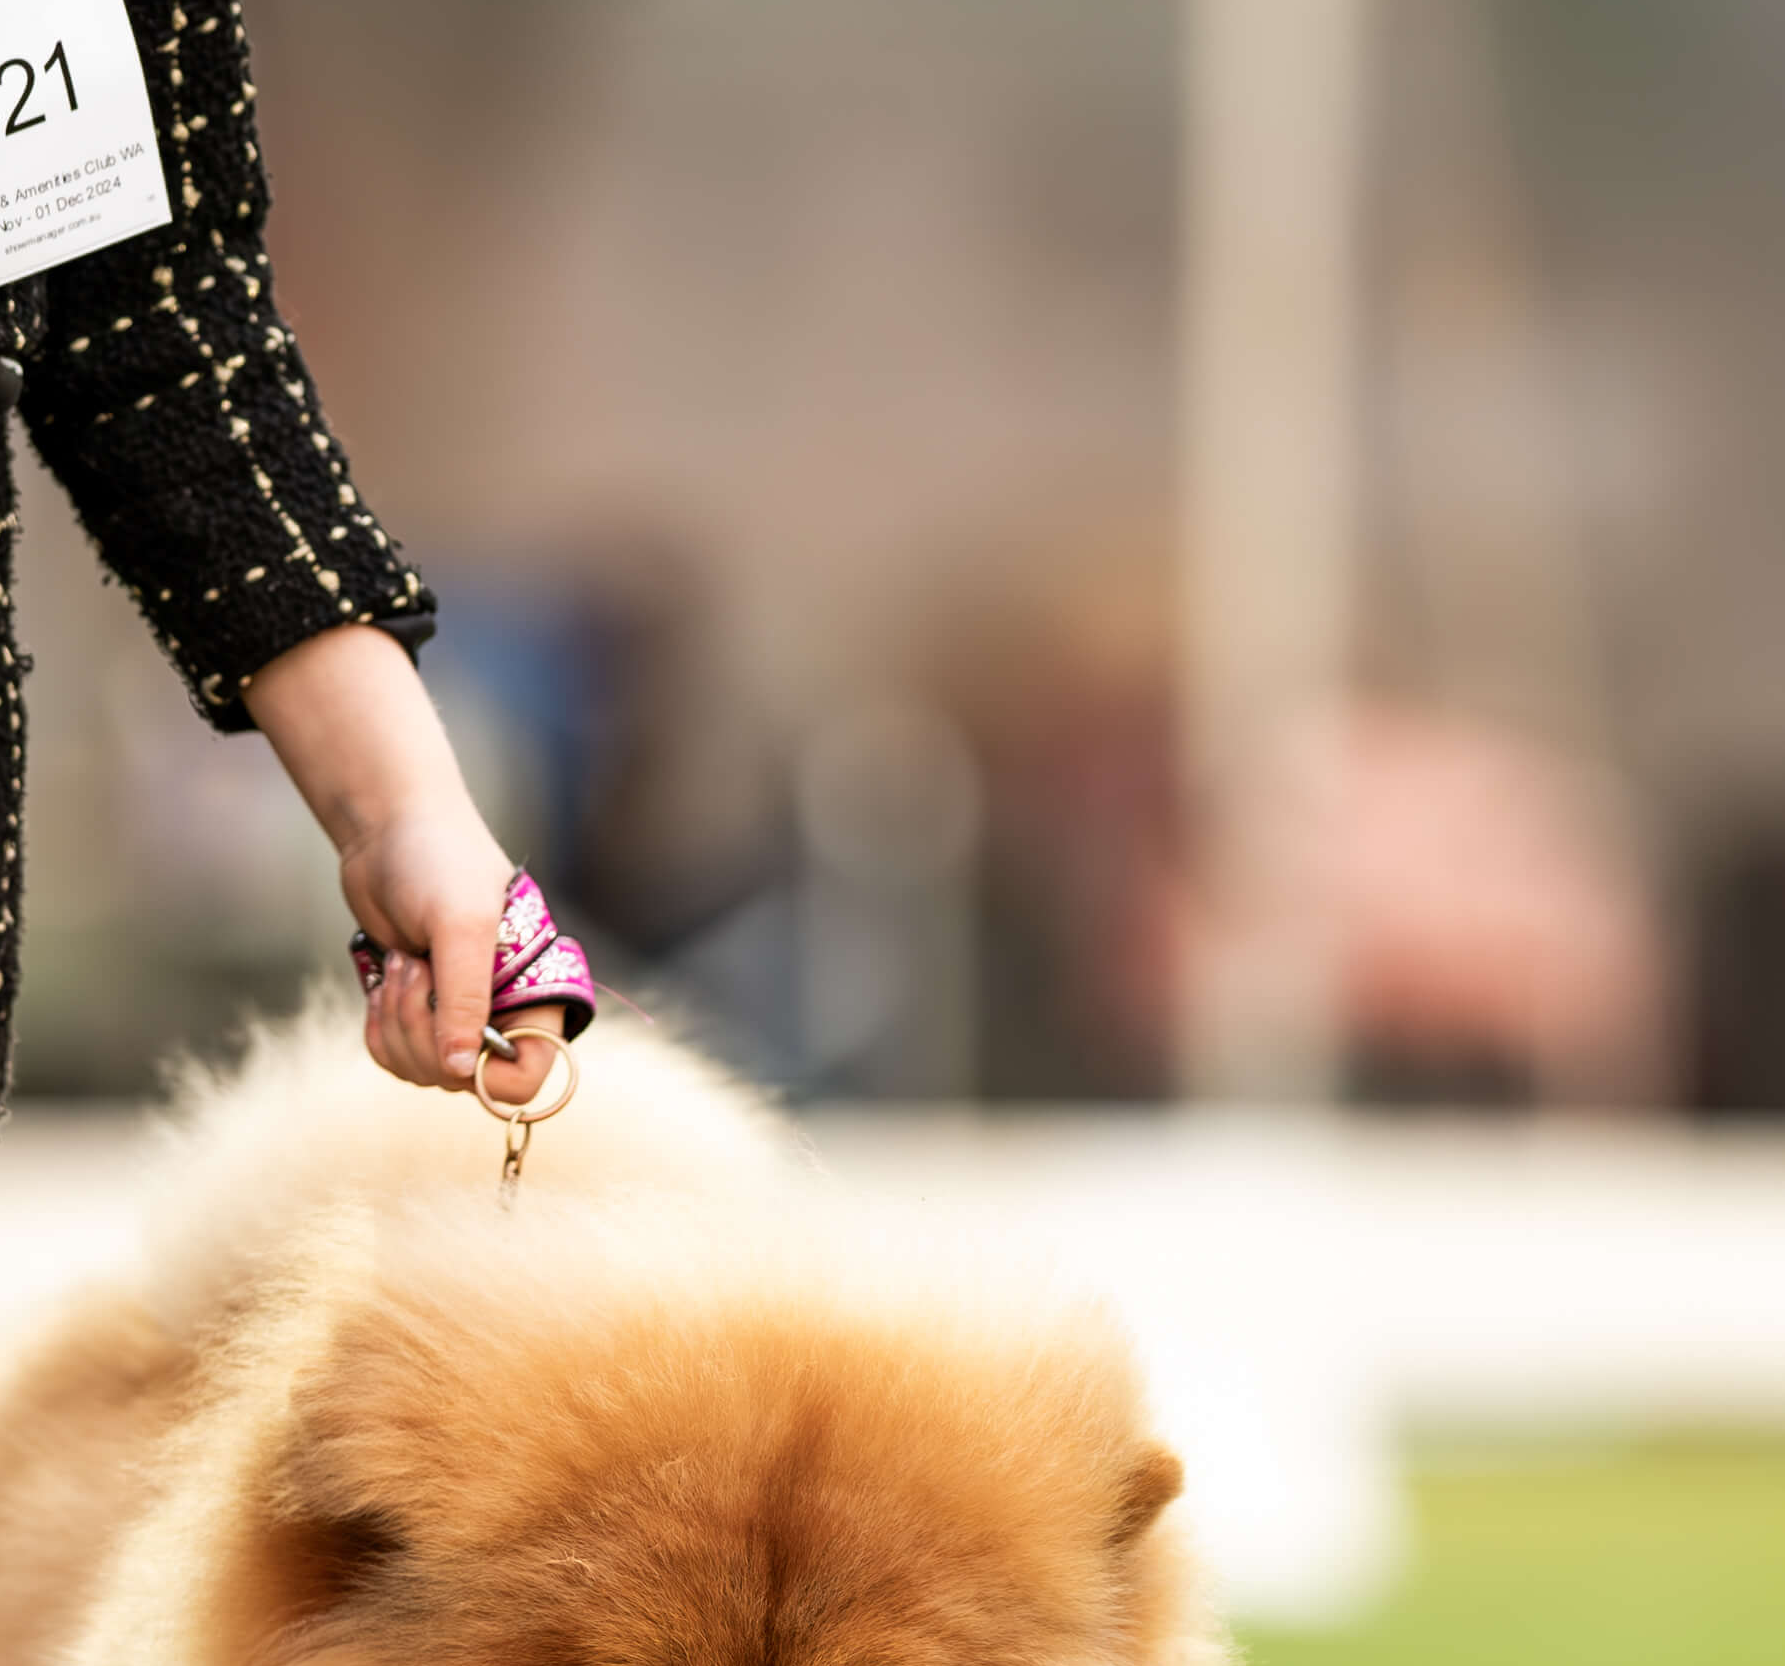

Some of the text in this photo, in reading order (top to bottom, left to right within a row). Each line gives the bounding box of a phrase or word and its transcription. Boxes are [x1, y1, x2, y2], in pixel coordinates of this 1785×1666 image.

[0, 194, 10, 208] &
[14, 169, 82, 203] Amenities
[84, 155, 116, 175] Club
[119, 142, 145, 161] WA
[35, 203, 51, 220] 01
[55, 193, 84, 212] Dec
[86, 175, 122, 201] 2024
